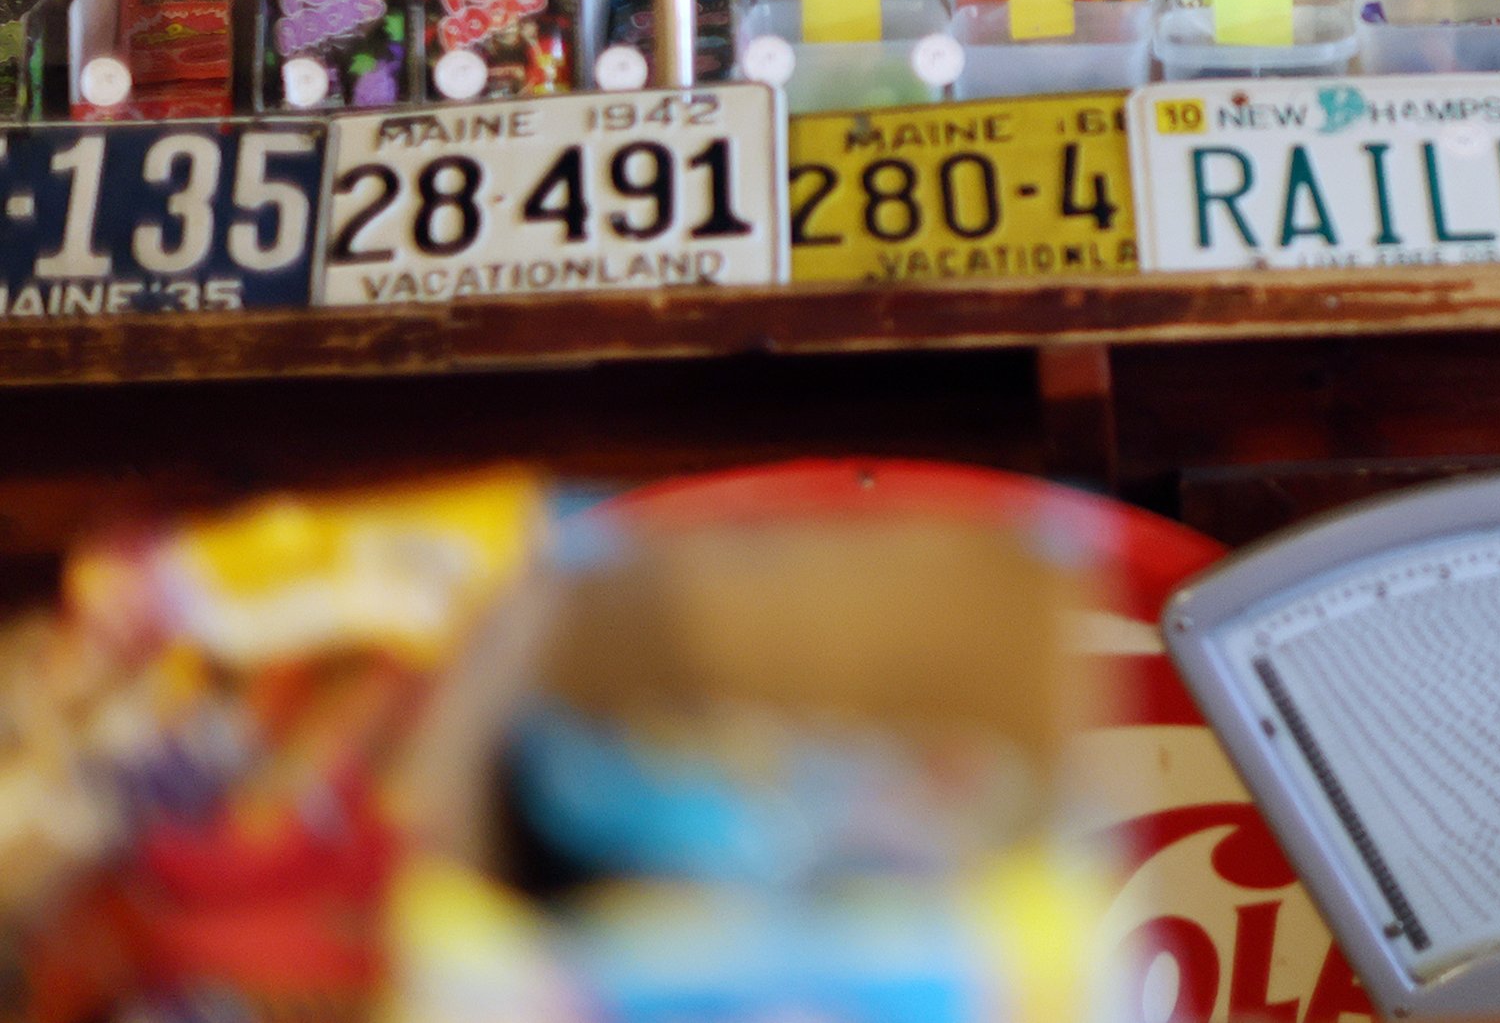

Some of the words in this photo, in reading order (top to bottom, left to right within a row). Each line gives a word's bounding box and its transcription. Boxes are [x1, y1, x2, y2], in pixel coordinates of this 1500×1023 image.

[374, 108, 537, 150] MAINE
[587, 95, 722, 132] 1942
[844, 112, 1015, 154] MAINE
[1167, 107, 1202, 127] 10
[1216, 103, 1309, 132] NEW
[0, 132, 310, 277] -135
[790, 142, 1118, 250] 280-4
[0, 281, 145, 317] AINE
[361, 249, 725, 301] VACATIONLAND
